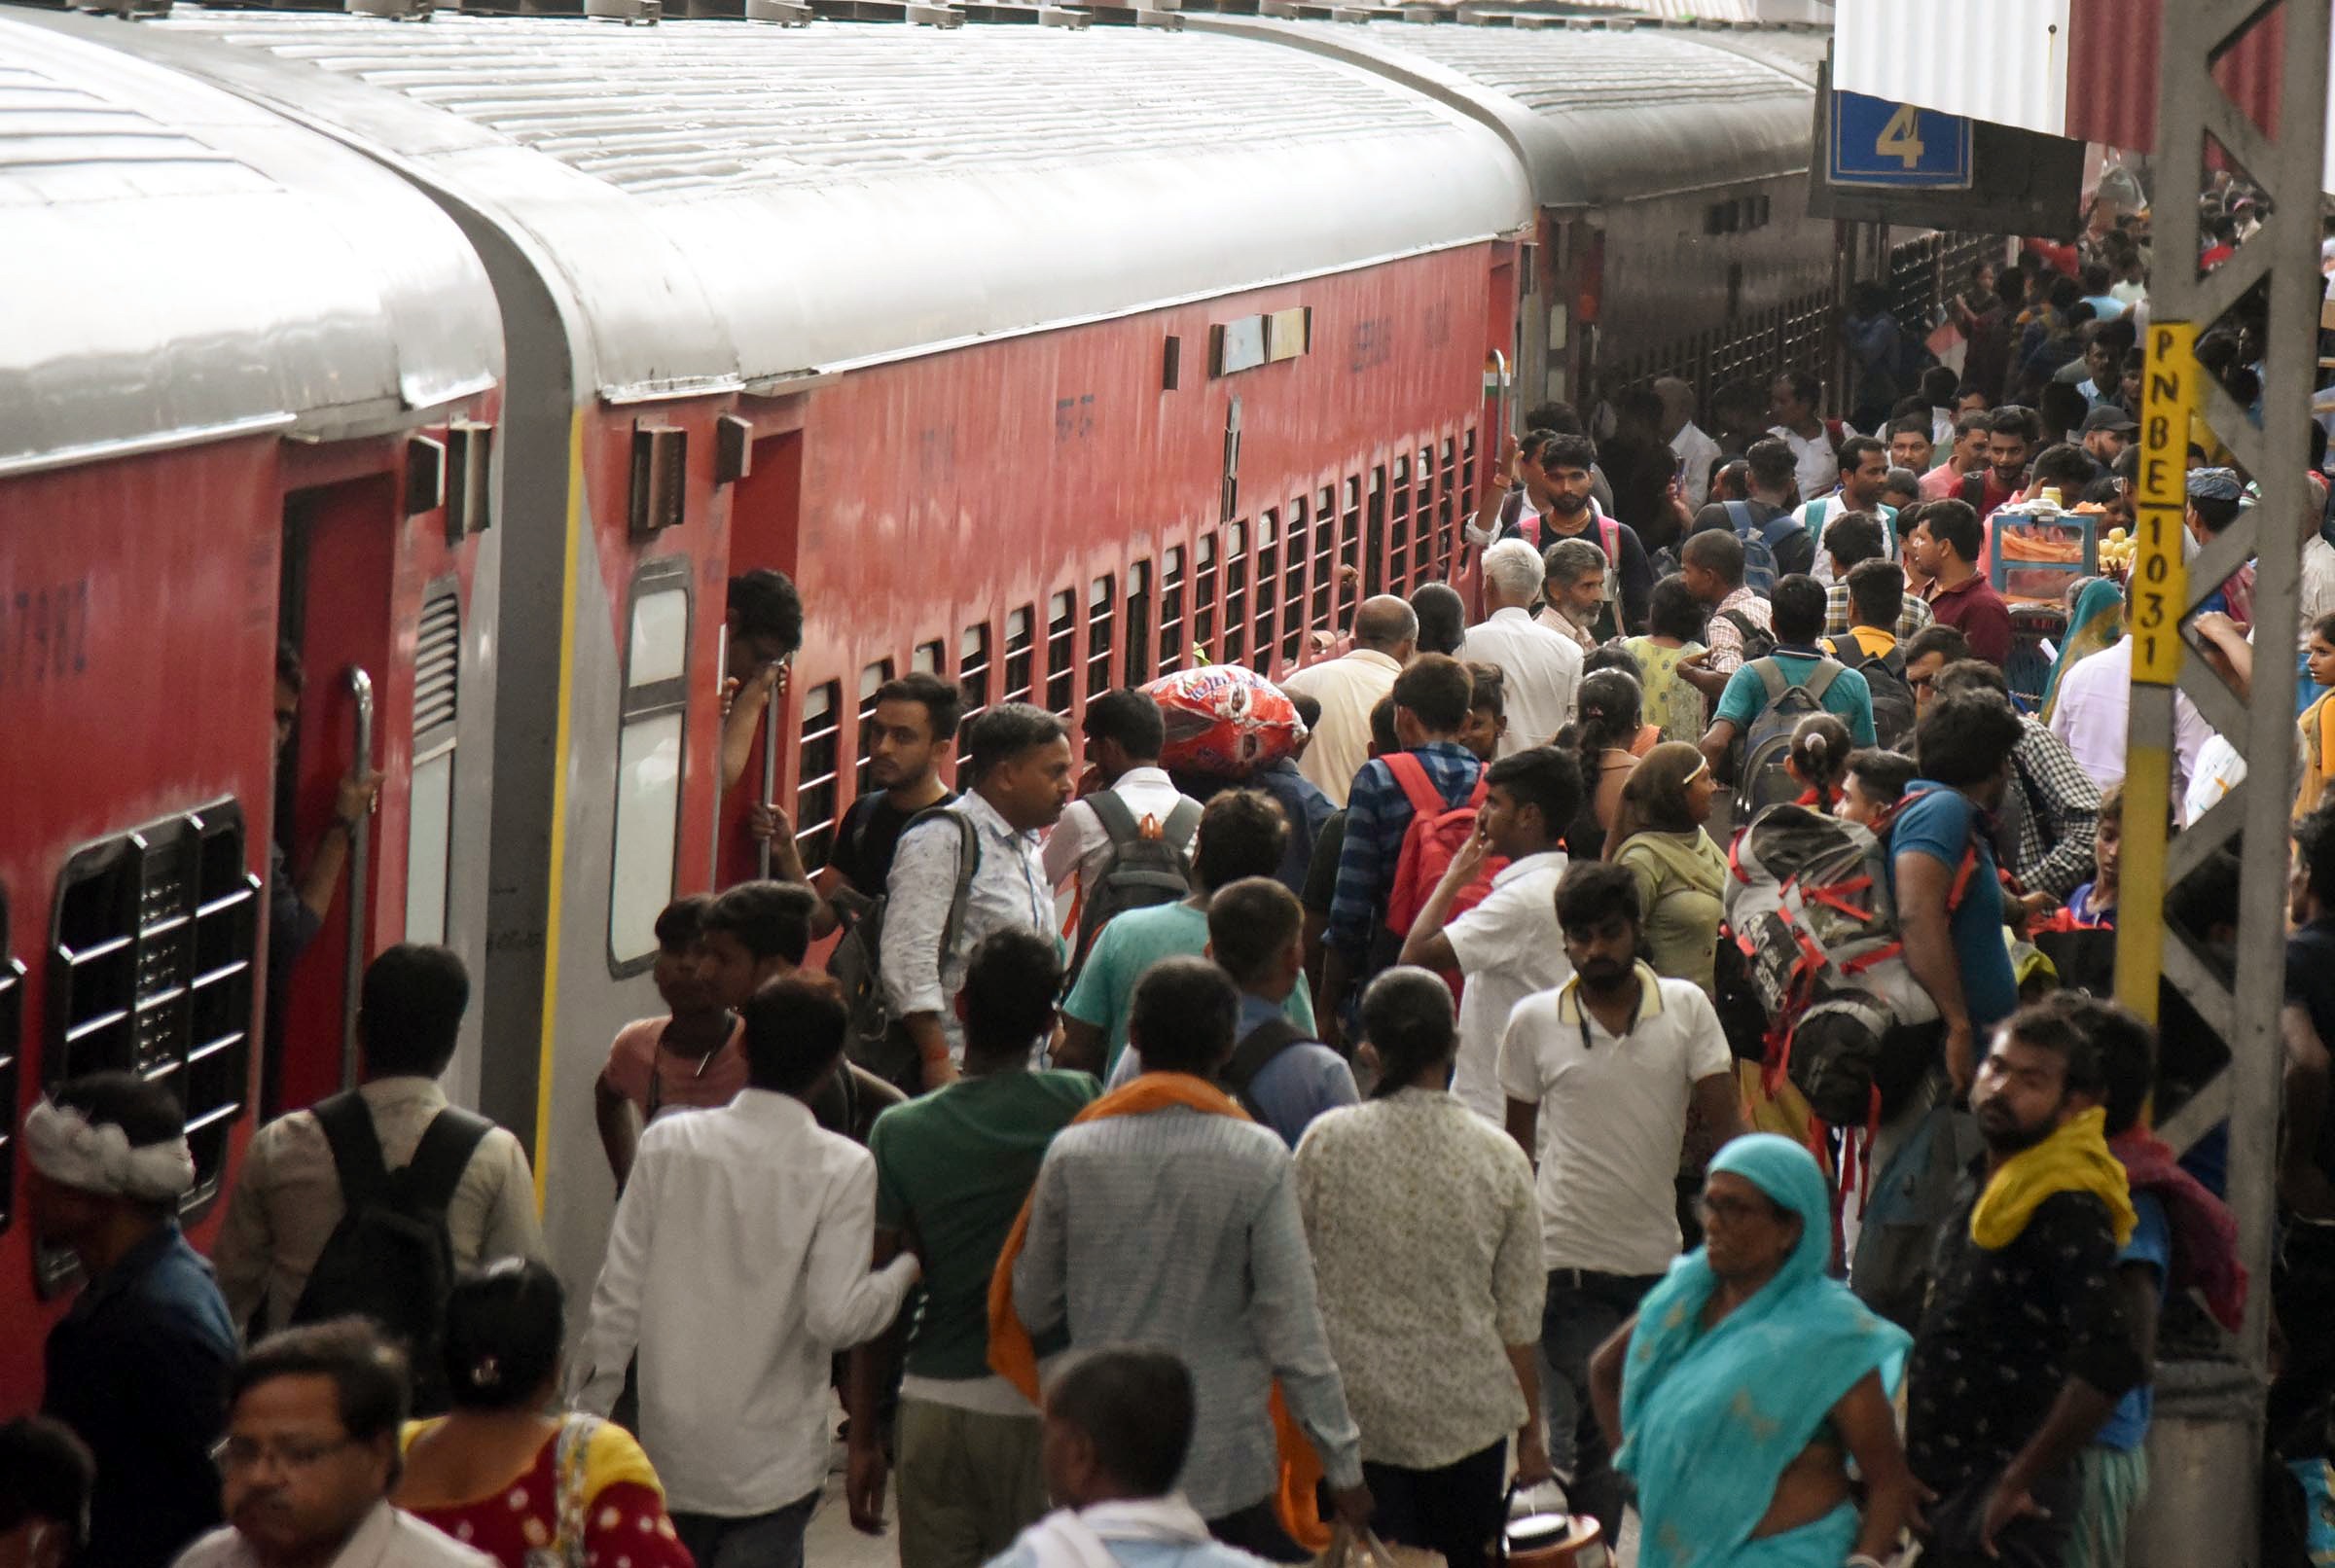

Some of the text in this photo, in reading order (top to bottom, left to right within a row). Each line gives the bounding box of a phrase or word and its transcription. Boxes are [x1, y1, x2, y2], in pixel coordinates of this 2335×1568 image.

[1876, 104, 1924, 168] 4
[2141, 329, 2180, 666] PNBE 1031
